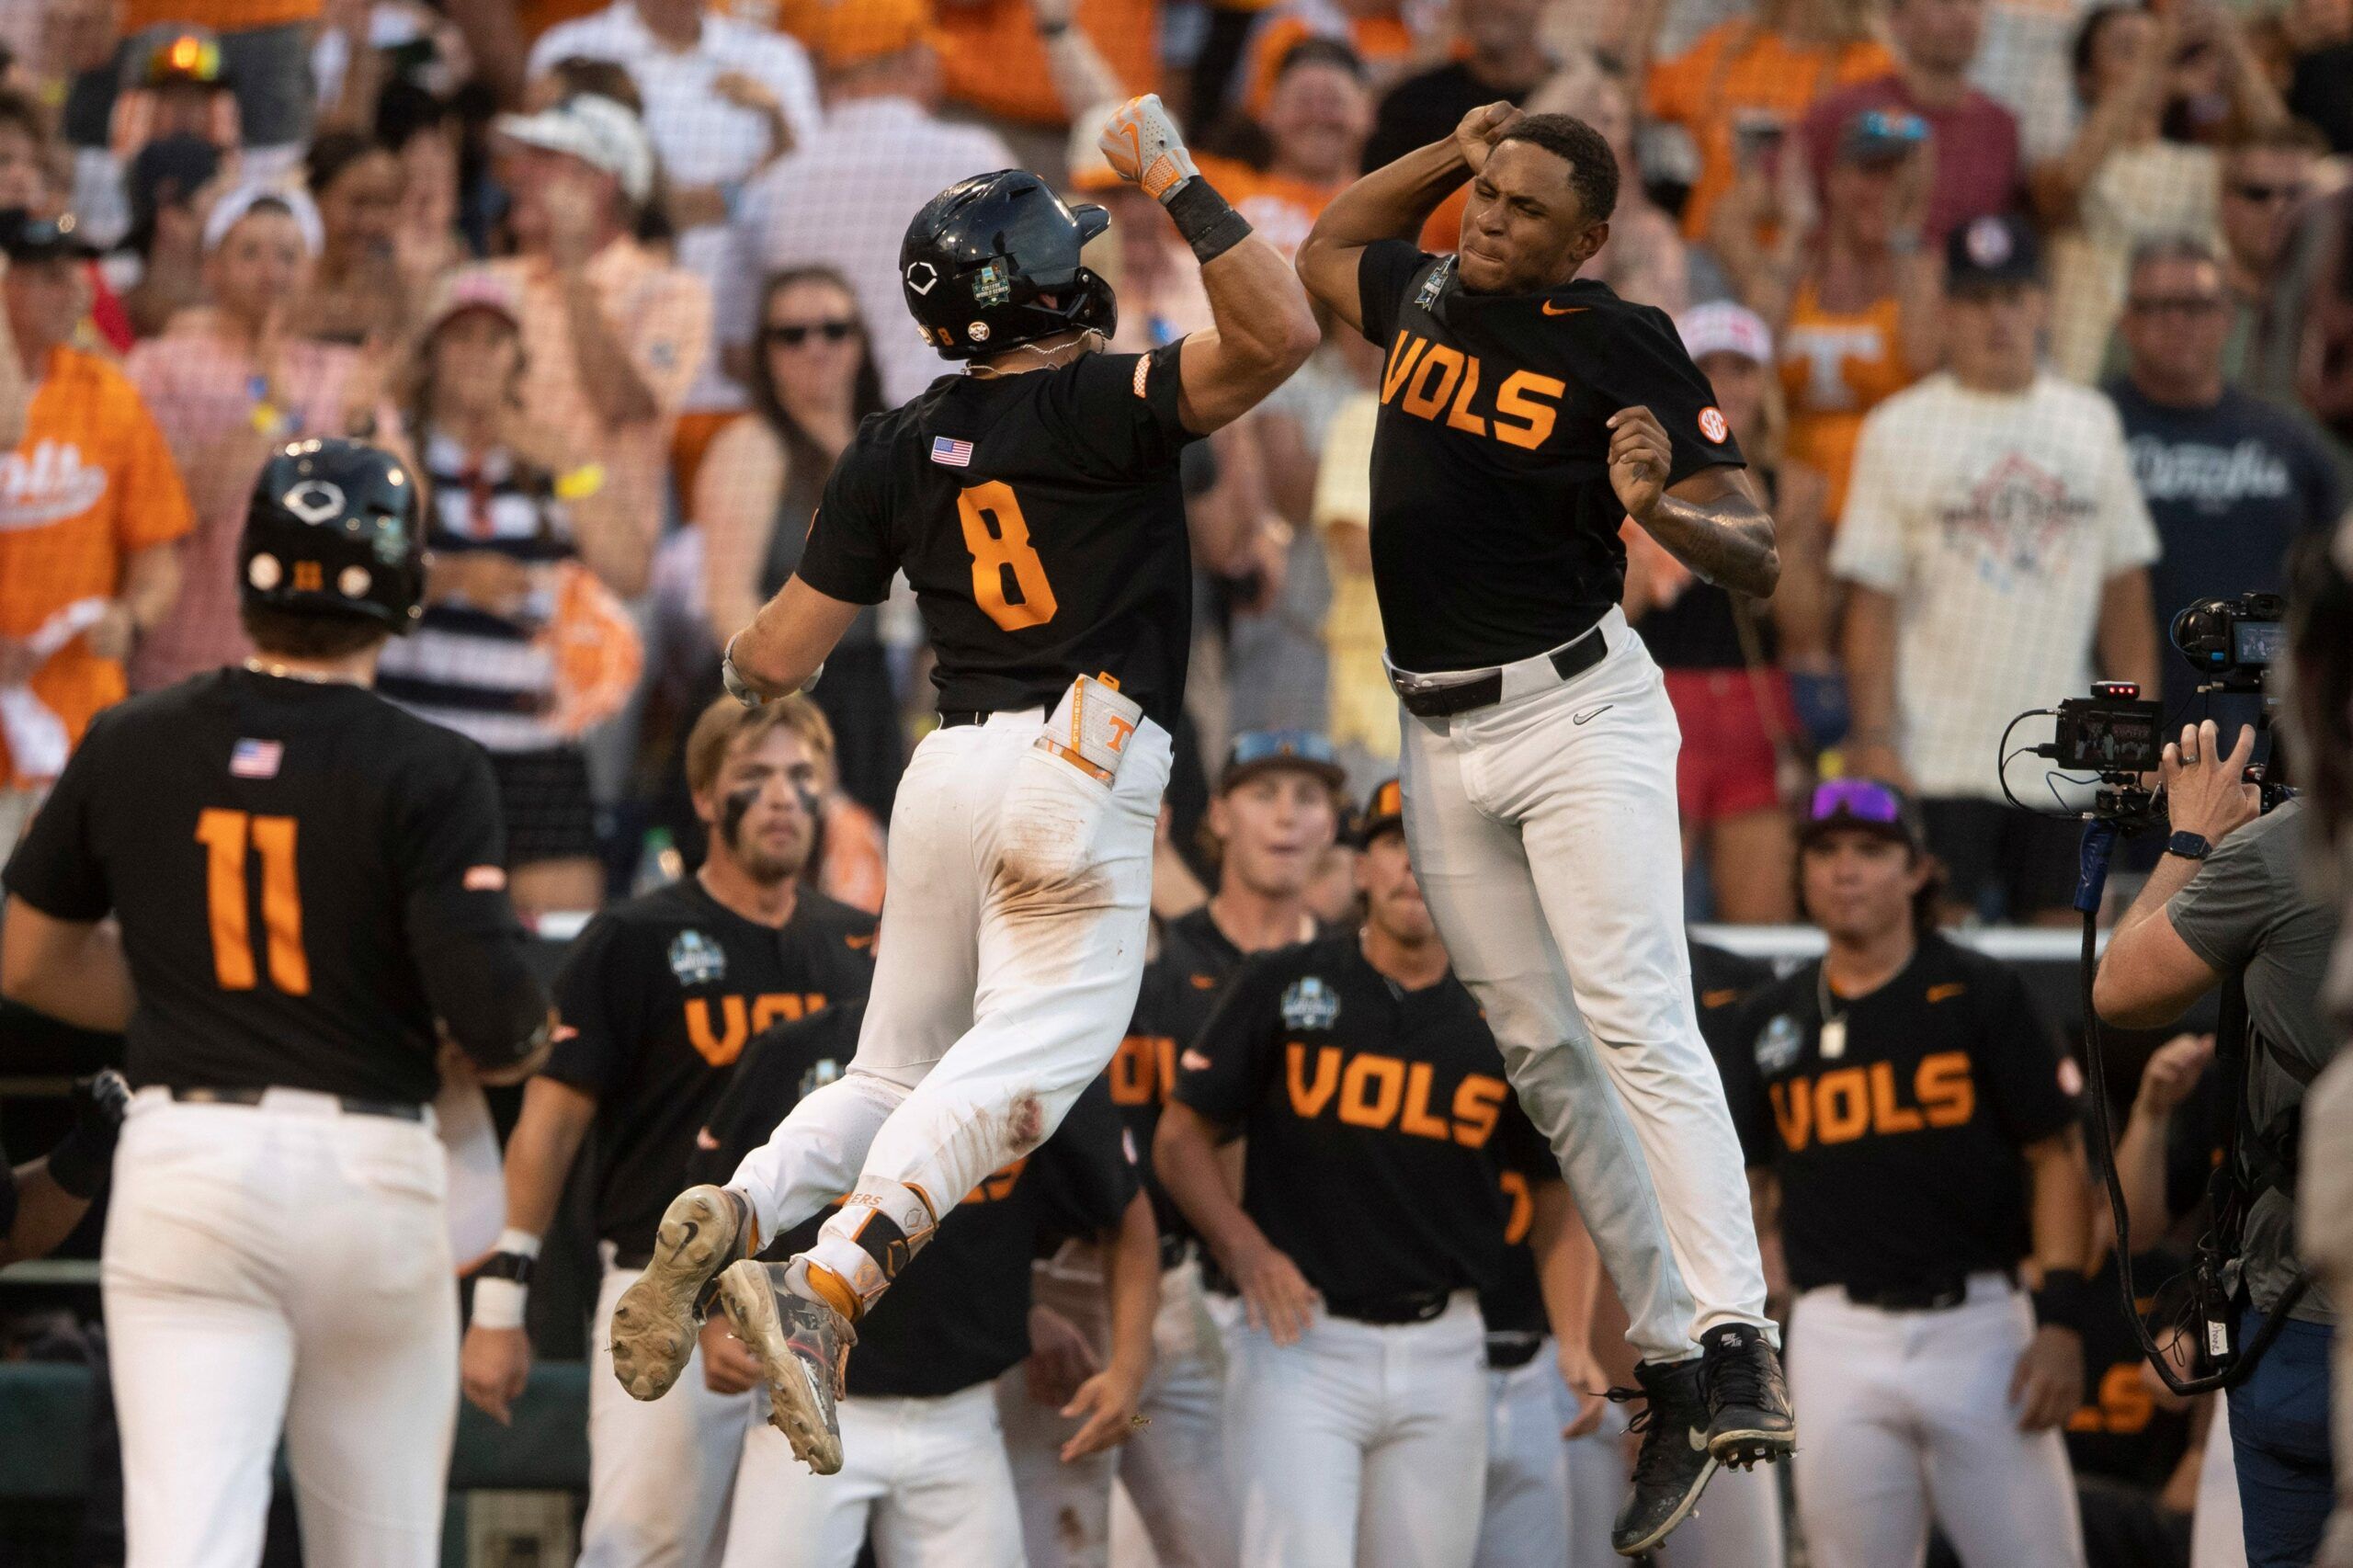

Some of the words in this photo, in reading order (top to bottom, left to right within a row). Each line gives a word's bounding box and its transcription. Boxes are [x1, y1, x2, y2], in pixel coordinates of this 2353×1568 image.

[938, 327, 954, 346] 8
[1785, 326, 1882, 409] T
[1381, 329, 1566, 450] VOLS
[1700, 409, 1725, 440] SEC
[957, 480, 1058, 631] 8
[1073, 687, 1083, 743] EVOSHIELD
[1107, 715, 1136, 753] T
[195, 807, 311, 995] 11
[1287, 1042, 1508, 1149] VOLS
[1769, 1051, 1975, 1152] VOLS
[850, 1193, 883, 1205] ERS
